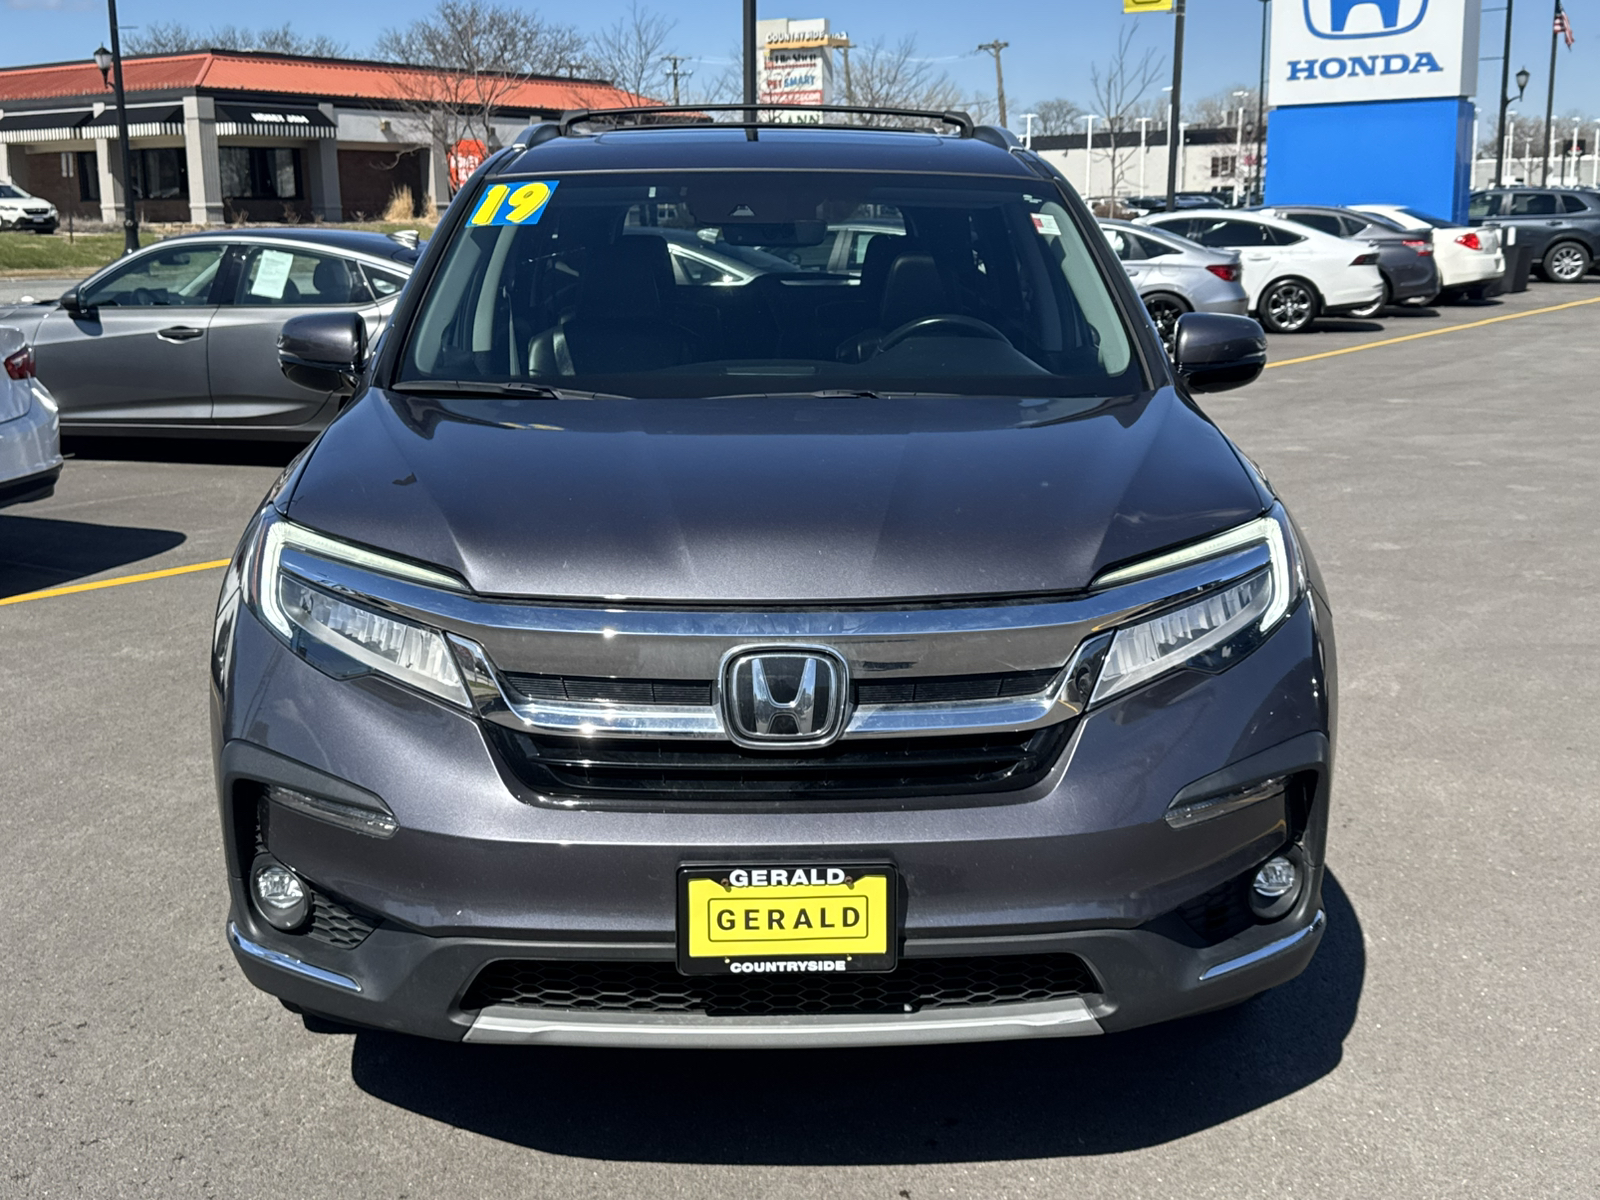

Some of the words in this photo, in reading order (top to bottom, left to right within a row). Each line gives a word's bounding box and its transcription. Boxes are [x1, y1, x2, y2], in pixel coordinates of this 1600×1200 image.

[766, 31, 824, 45] COUNTRYSIDE
[1287, 52, 1444, 81] HONDA
[471, 182, 551, 227] 19
[729, 868, 845, 888] GERALD
[716, 906, 860, 931] GERALD
[730, 960, 846, 974] COUNTRYSIDE
